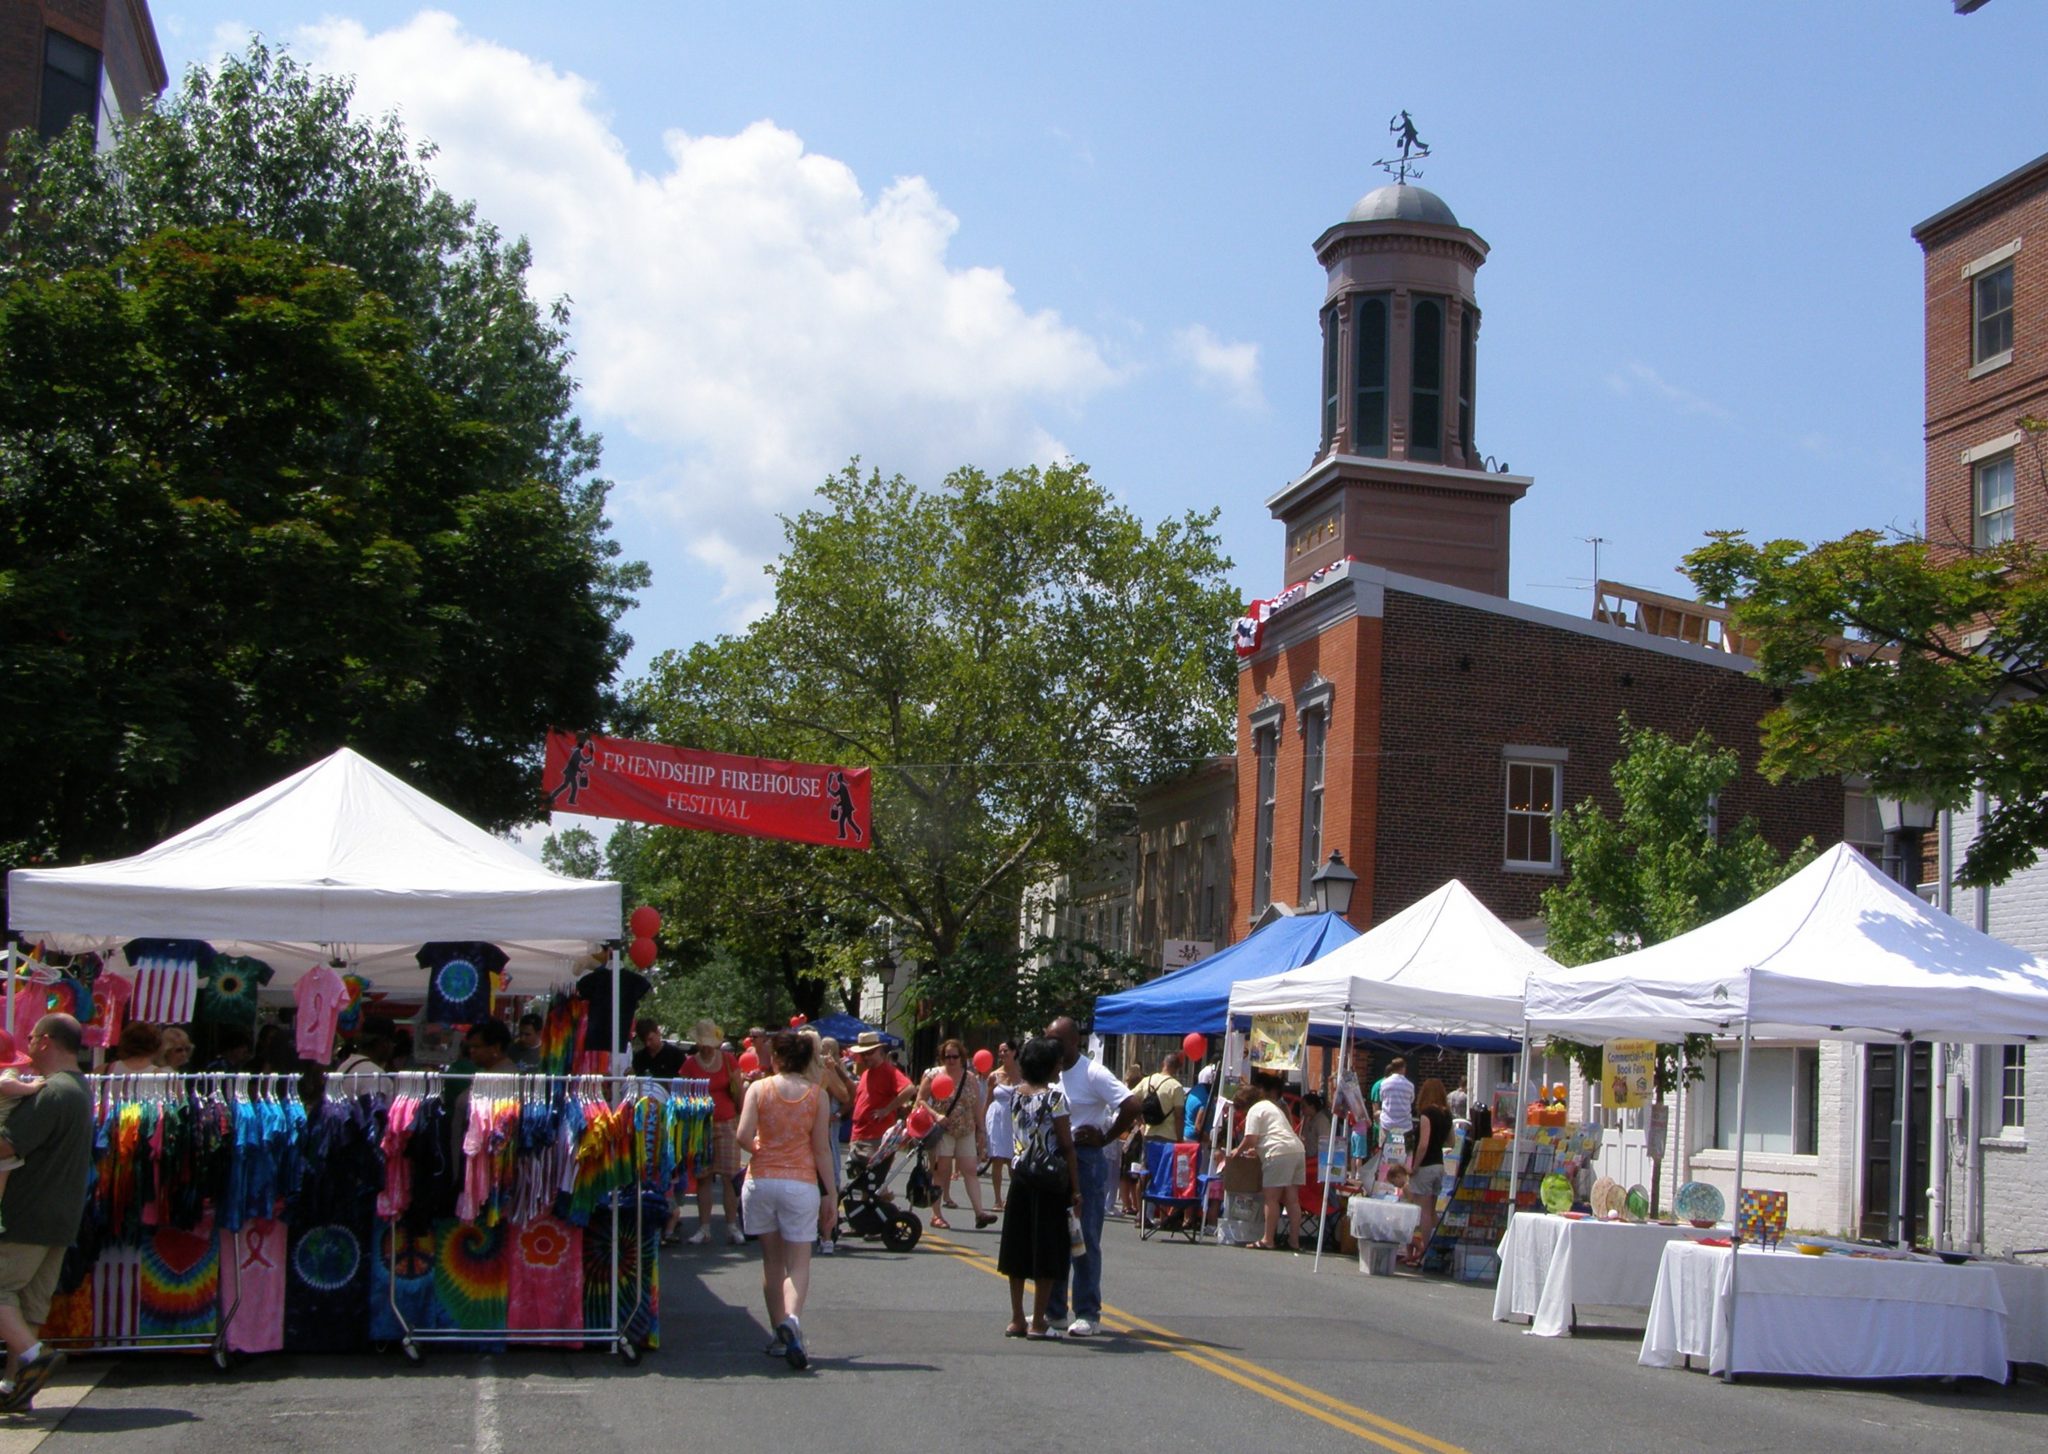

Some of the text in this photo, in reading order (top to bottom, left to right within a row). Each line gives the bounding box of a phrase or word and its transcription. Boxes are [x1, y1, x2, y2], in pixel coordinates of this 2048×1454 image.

[602, 751, 821, 798] FRIENDSHIP FIREHOUSE
[666, 791, 750, 820] FESTIVAL
[1616, 1064, 1631, 1075] Book
